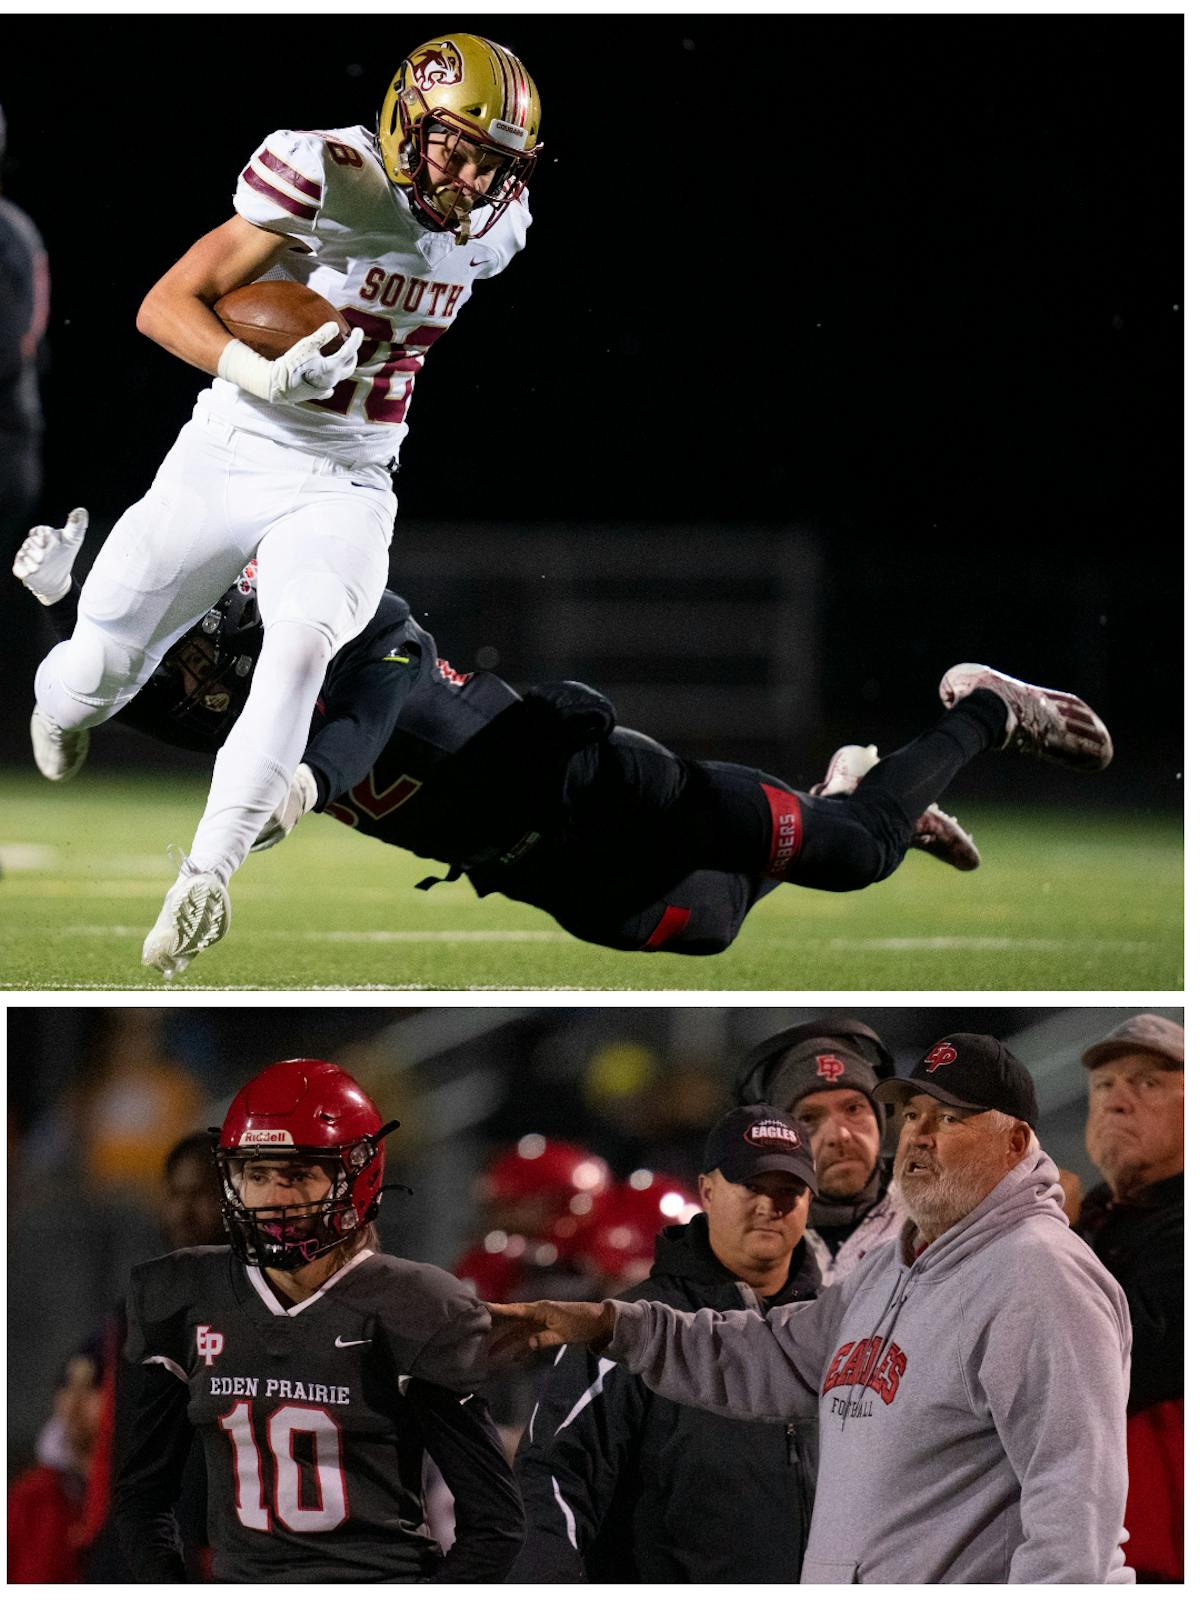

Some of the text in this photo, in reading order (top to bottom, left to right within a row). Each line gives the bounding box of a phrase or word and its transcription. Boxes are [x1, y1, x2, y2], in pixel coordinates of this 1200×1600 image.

[360, 266, 465, 318] SOUTH
[245, 1132, 286, 1143] Riddell
[751, 1125, 797, 1143] EAGLES
[195, 1324, 224, 1367] EP
[210, 1377, 351, 1405] EDEN PRAIRIE
[217, 1399, 350, 1533] 10
